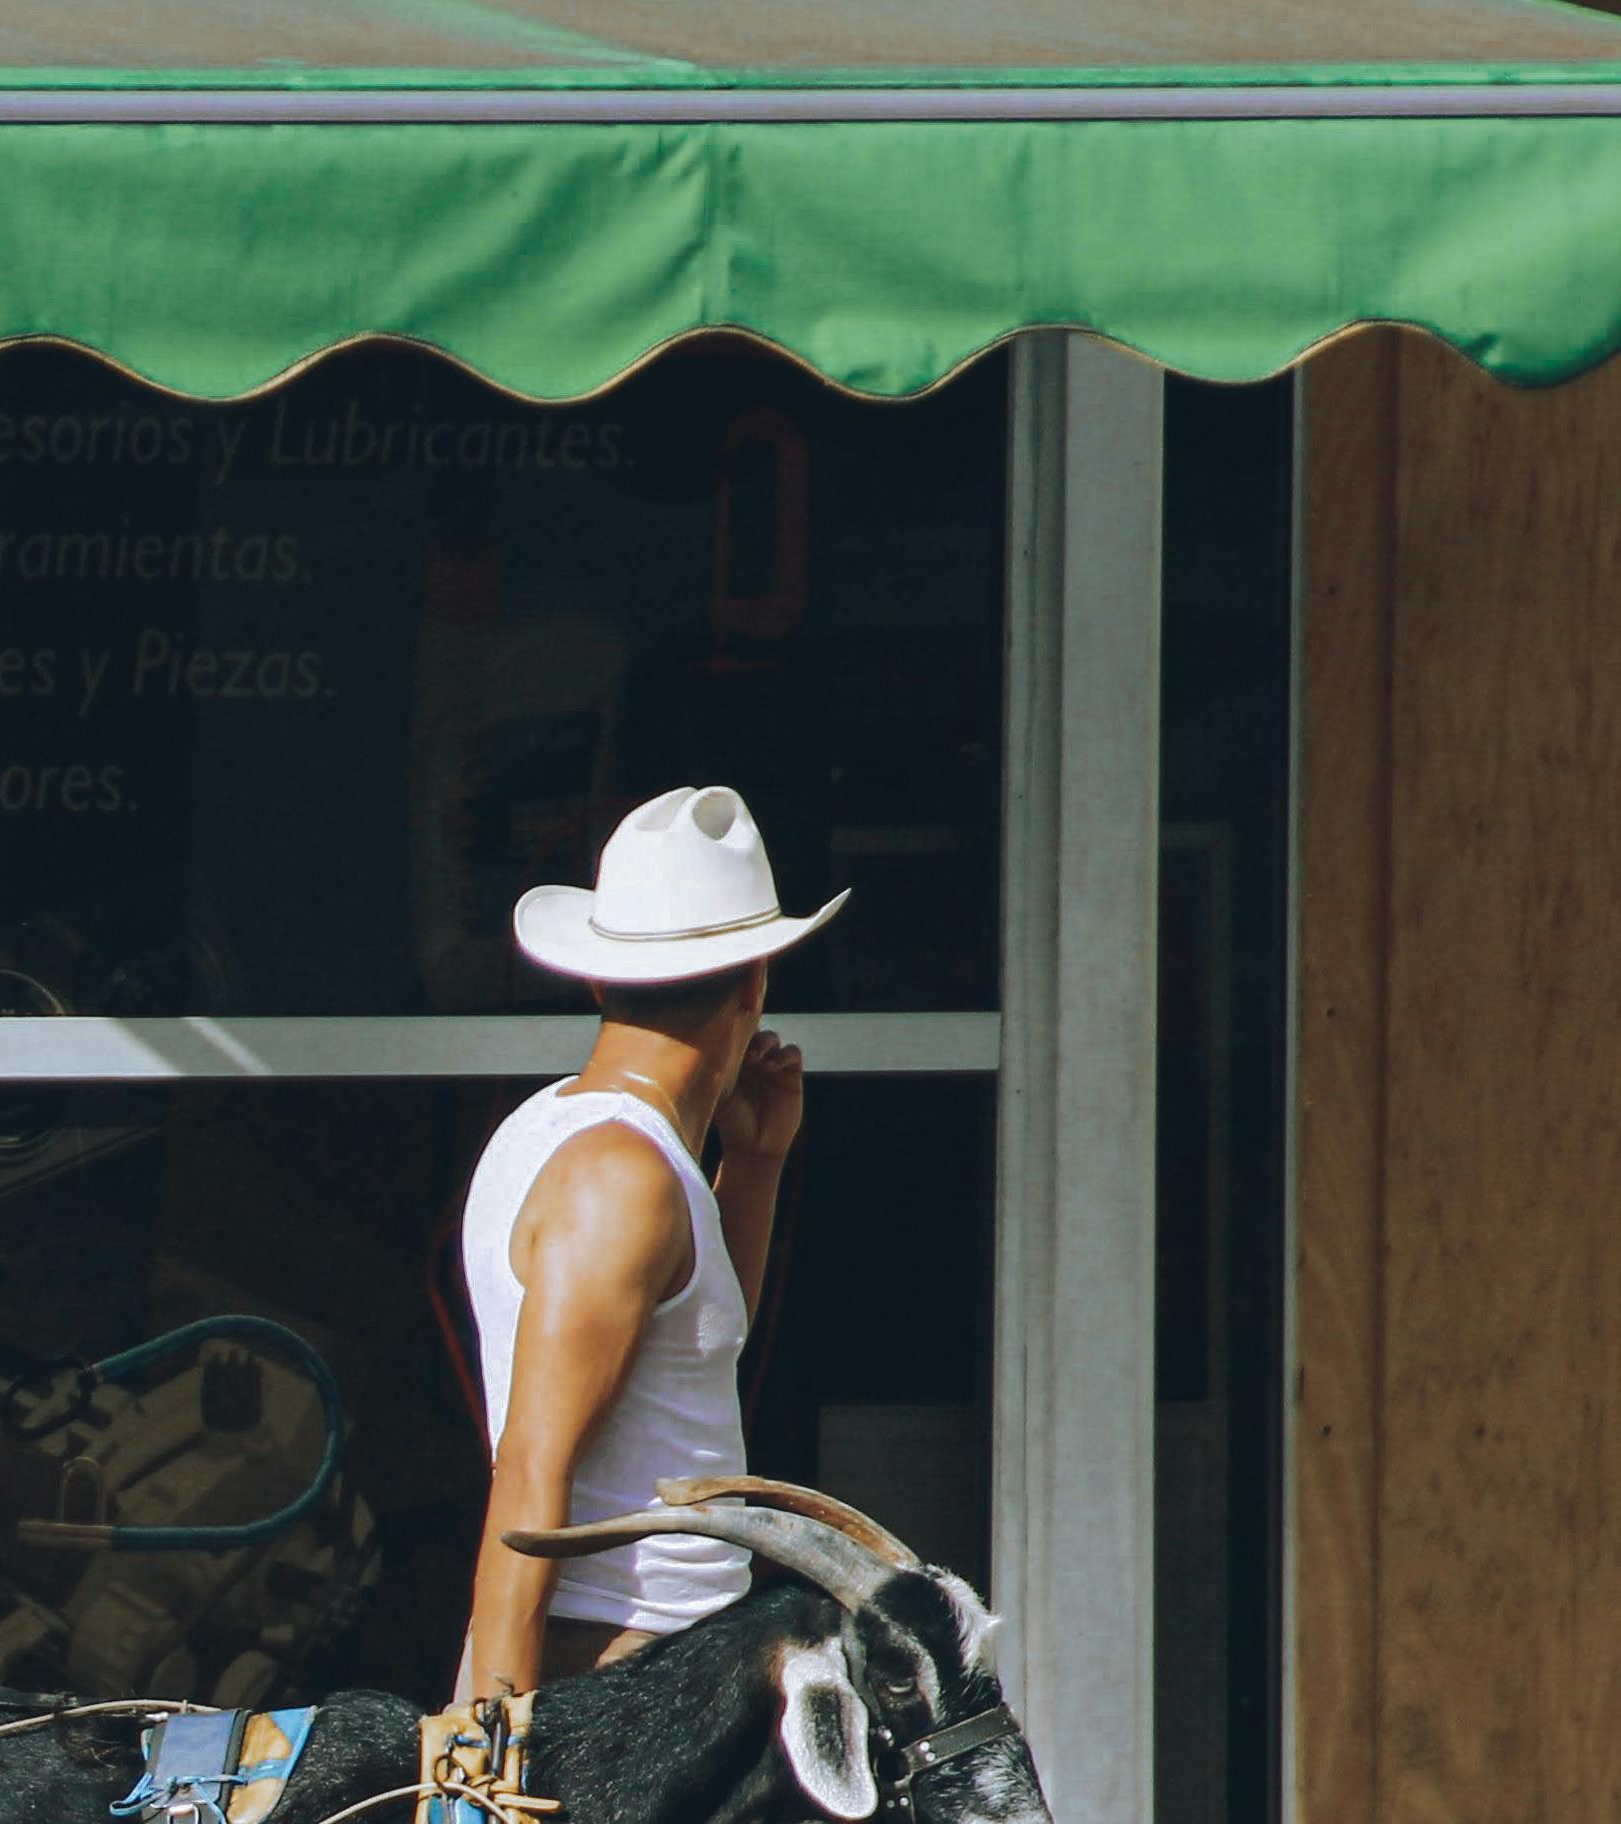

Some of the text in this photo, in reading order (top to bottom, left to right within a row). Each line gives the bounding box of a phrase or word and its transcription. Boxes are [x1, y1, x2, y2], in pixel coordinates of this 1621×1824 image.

[215, 416, 248, 485] y
[267, 395, 637, 469] Lubricantes.
[78, 649, 111, 718] y
[132, 627, 337, 698] Piezas.
